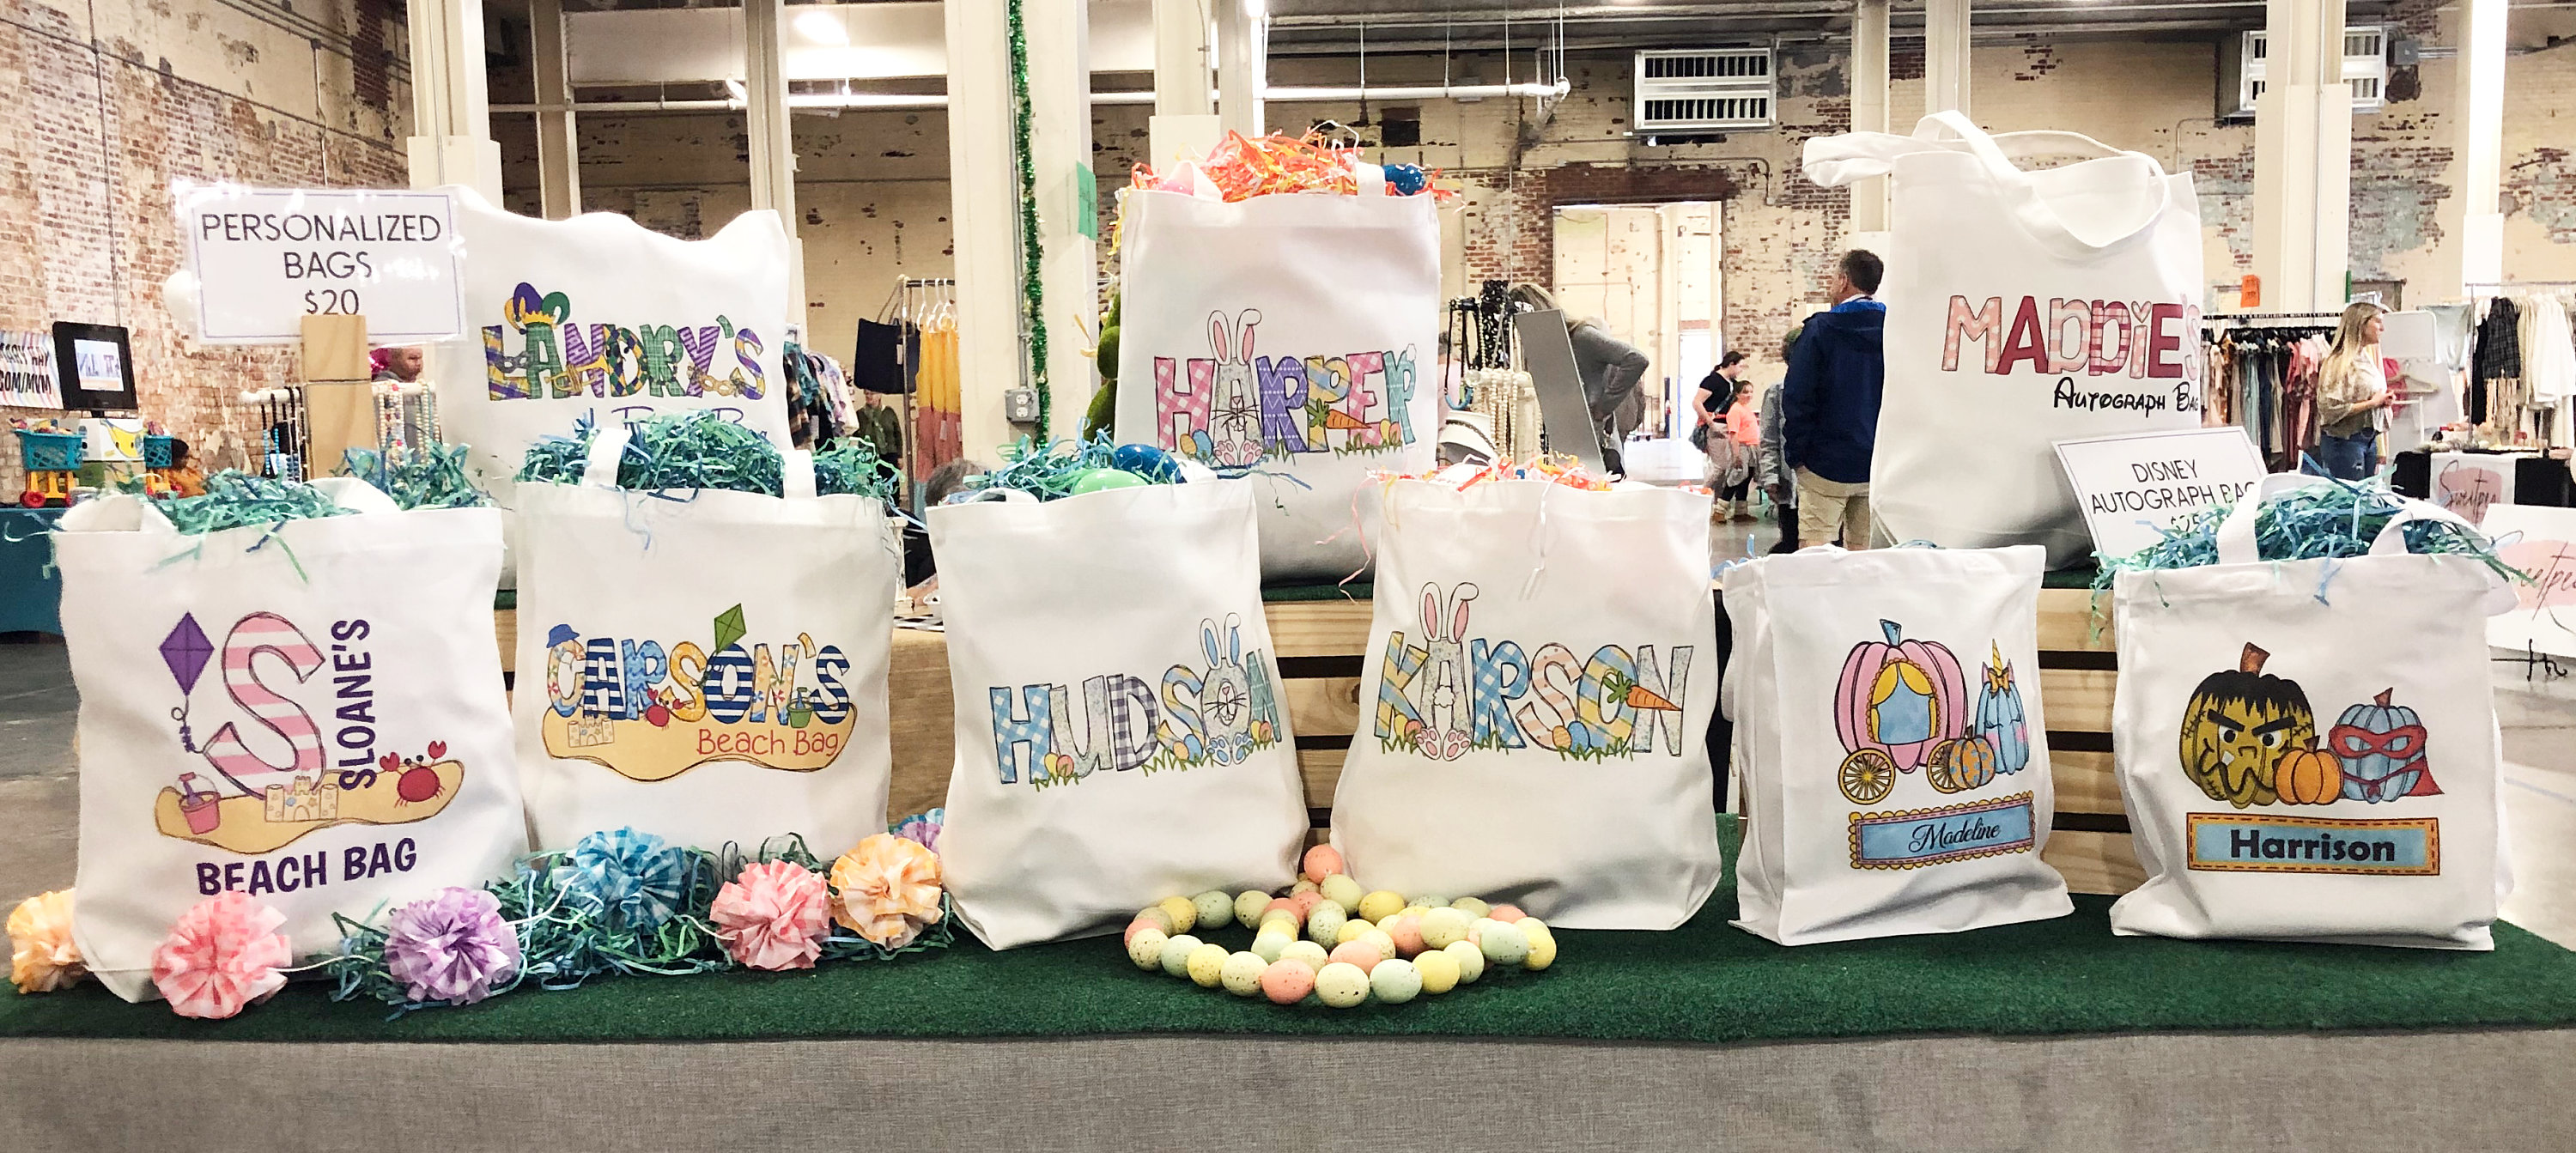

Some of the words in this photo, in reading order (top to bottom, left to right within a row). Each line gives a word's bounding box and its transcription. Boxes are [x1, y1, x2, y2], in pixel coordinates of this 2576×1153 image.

[201, 213, 441, 241] PERSONALIZED
[283, 251, 373, 280] BAGS
[304, 289, 360, 315] $20
[482, 314, 766, 401] LANDRY'S
[1154, 340, 1417, 464] HARPER
[2131, 458, 2198, 483] DISNEY
[2091, 485, 2216, 514] AUTOGRAPH
[547, 633, 850, 725] CARSON'S
[1373, 620, 1693, 760] KARSON
[331, 619, 376, 790] SLOANE'S
[989, 637, 1283, 786] HUDSON
[696, 728, 785, 756] Beach
[793, 730, 839, 757] Bag
[1908, 817, 2002, 853] Madeline
[2231, 829, 2395, 862] Harrison
[196, 851, 327, 896] BEACH
[343, 837, 417, 881] BAG
